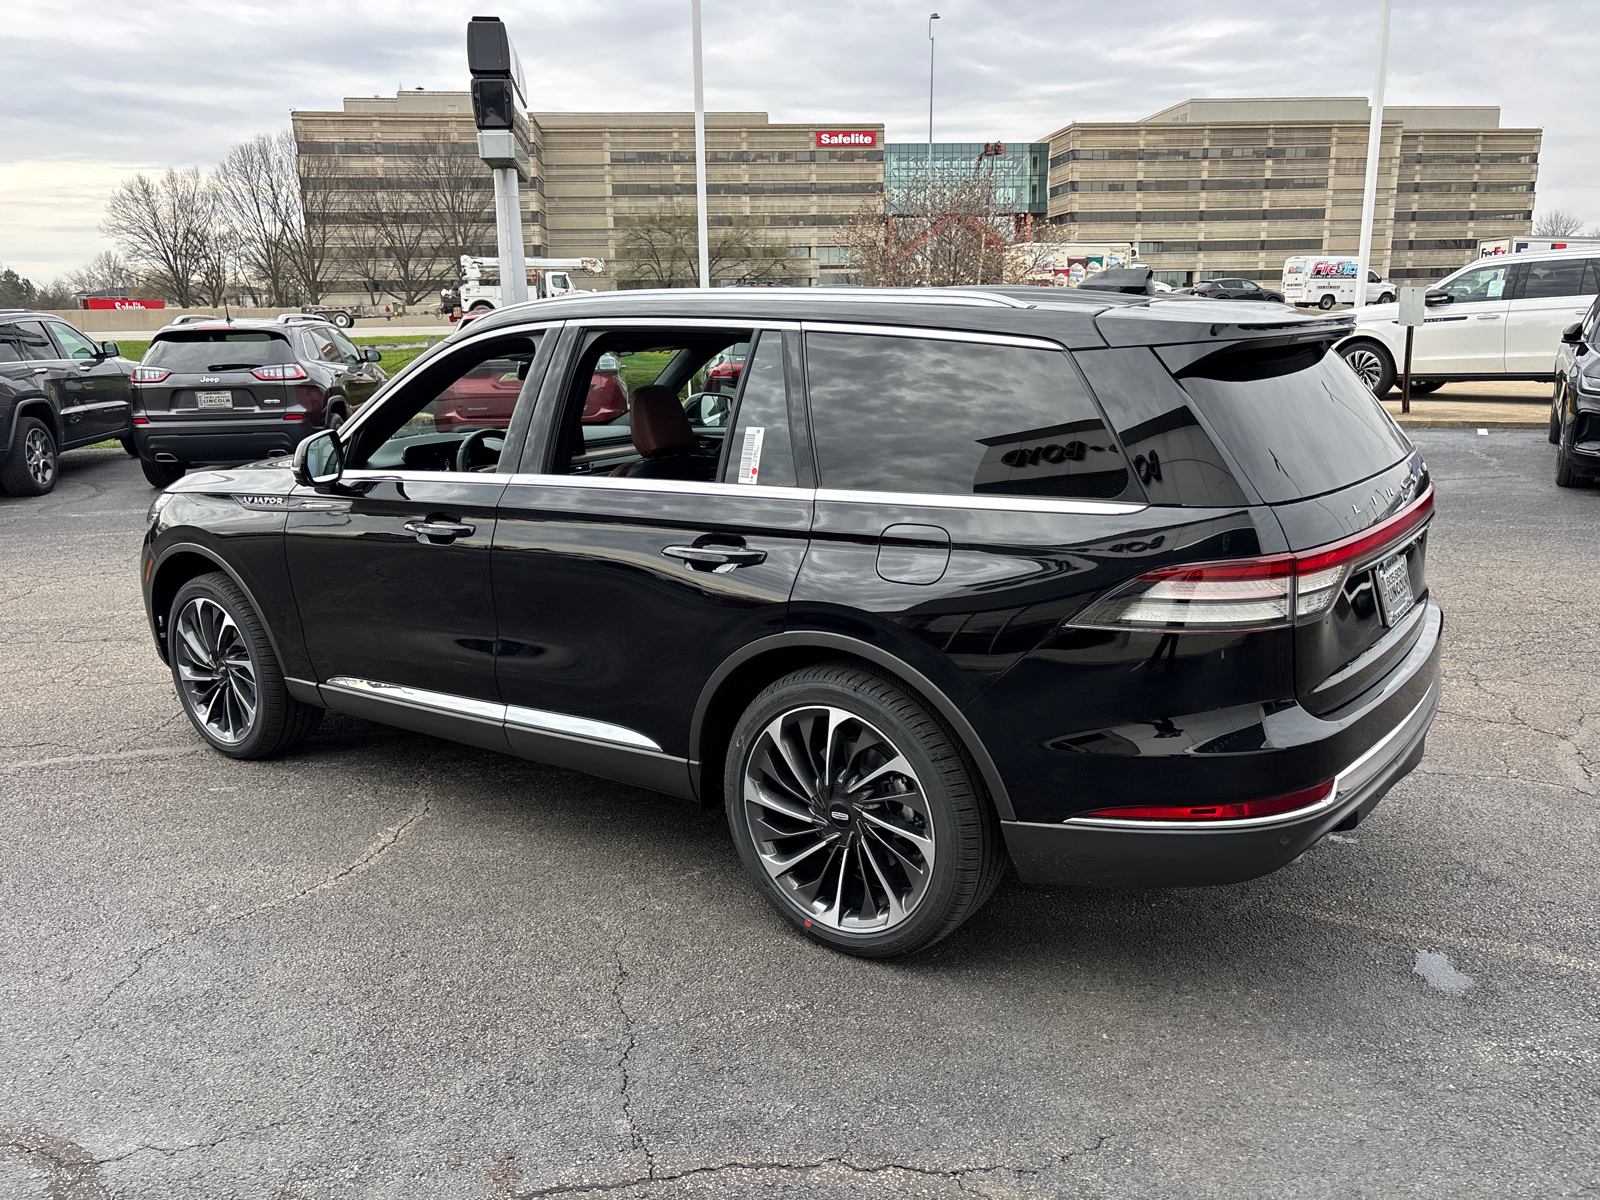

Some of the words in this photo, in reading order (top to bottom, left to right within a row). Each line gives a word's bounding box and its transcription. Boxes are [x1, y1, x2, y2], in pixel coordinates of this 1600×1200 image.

[820, 133, 873, 144] Safelite
[1481, 246, 1507, 258] FedEx
[243, 496, 283, 505] AVIATOR
